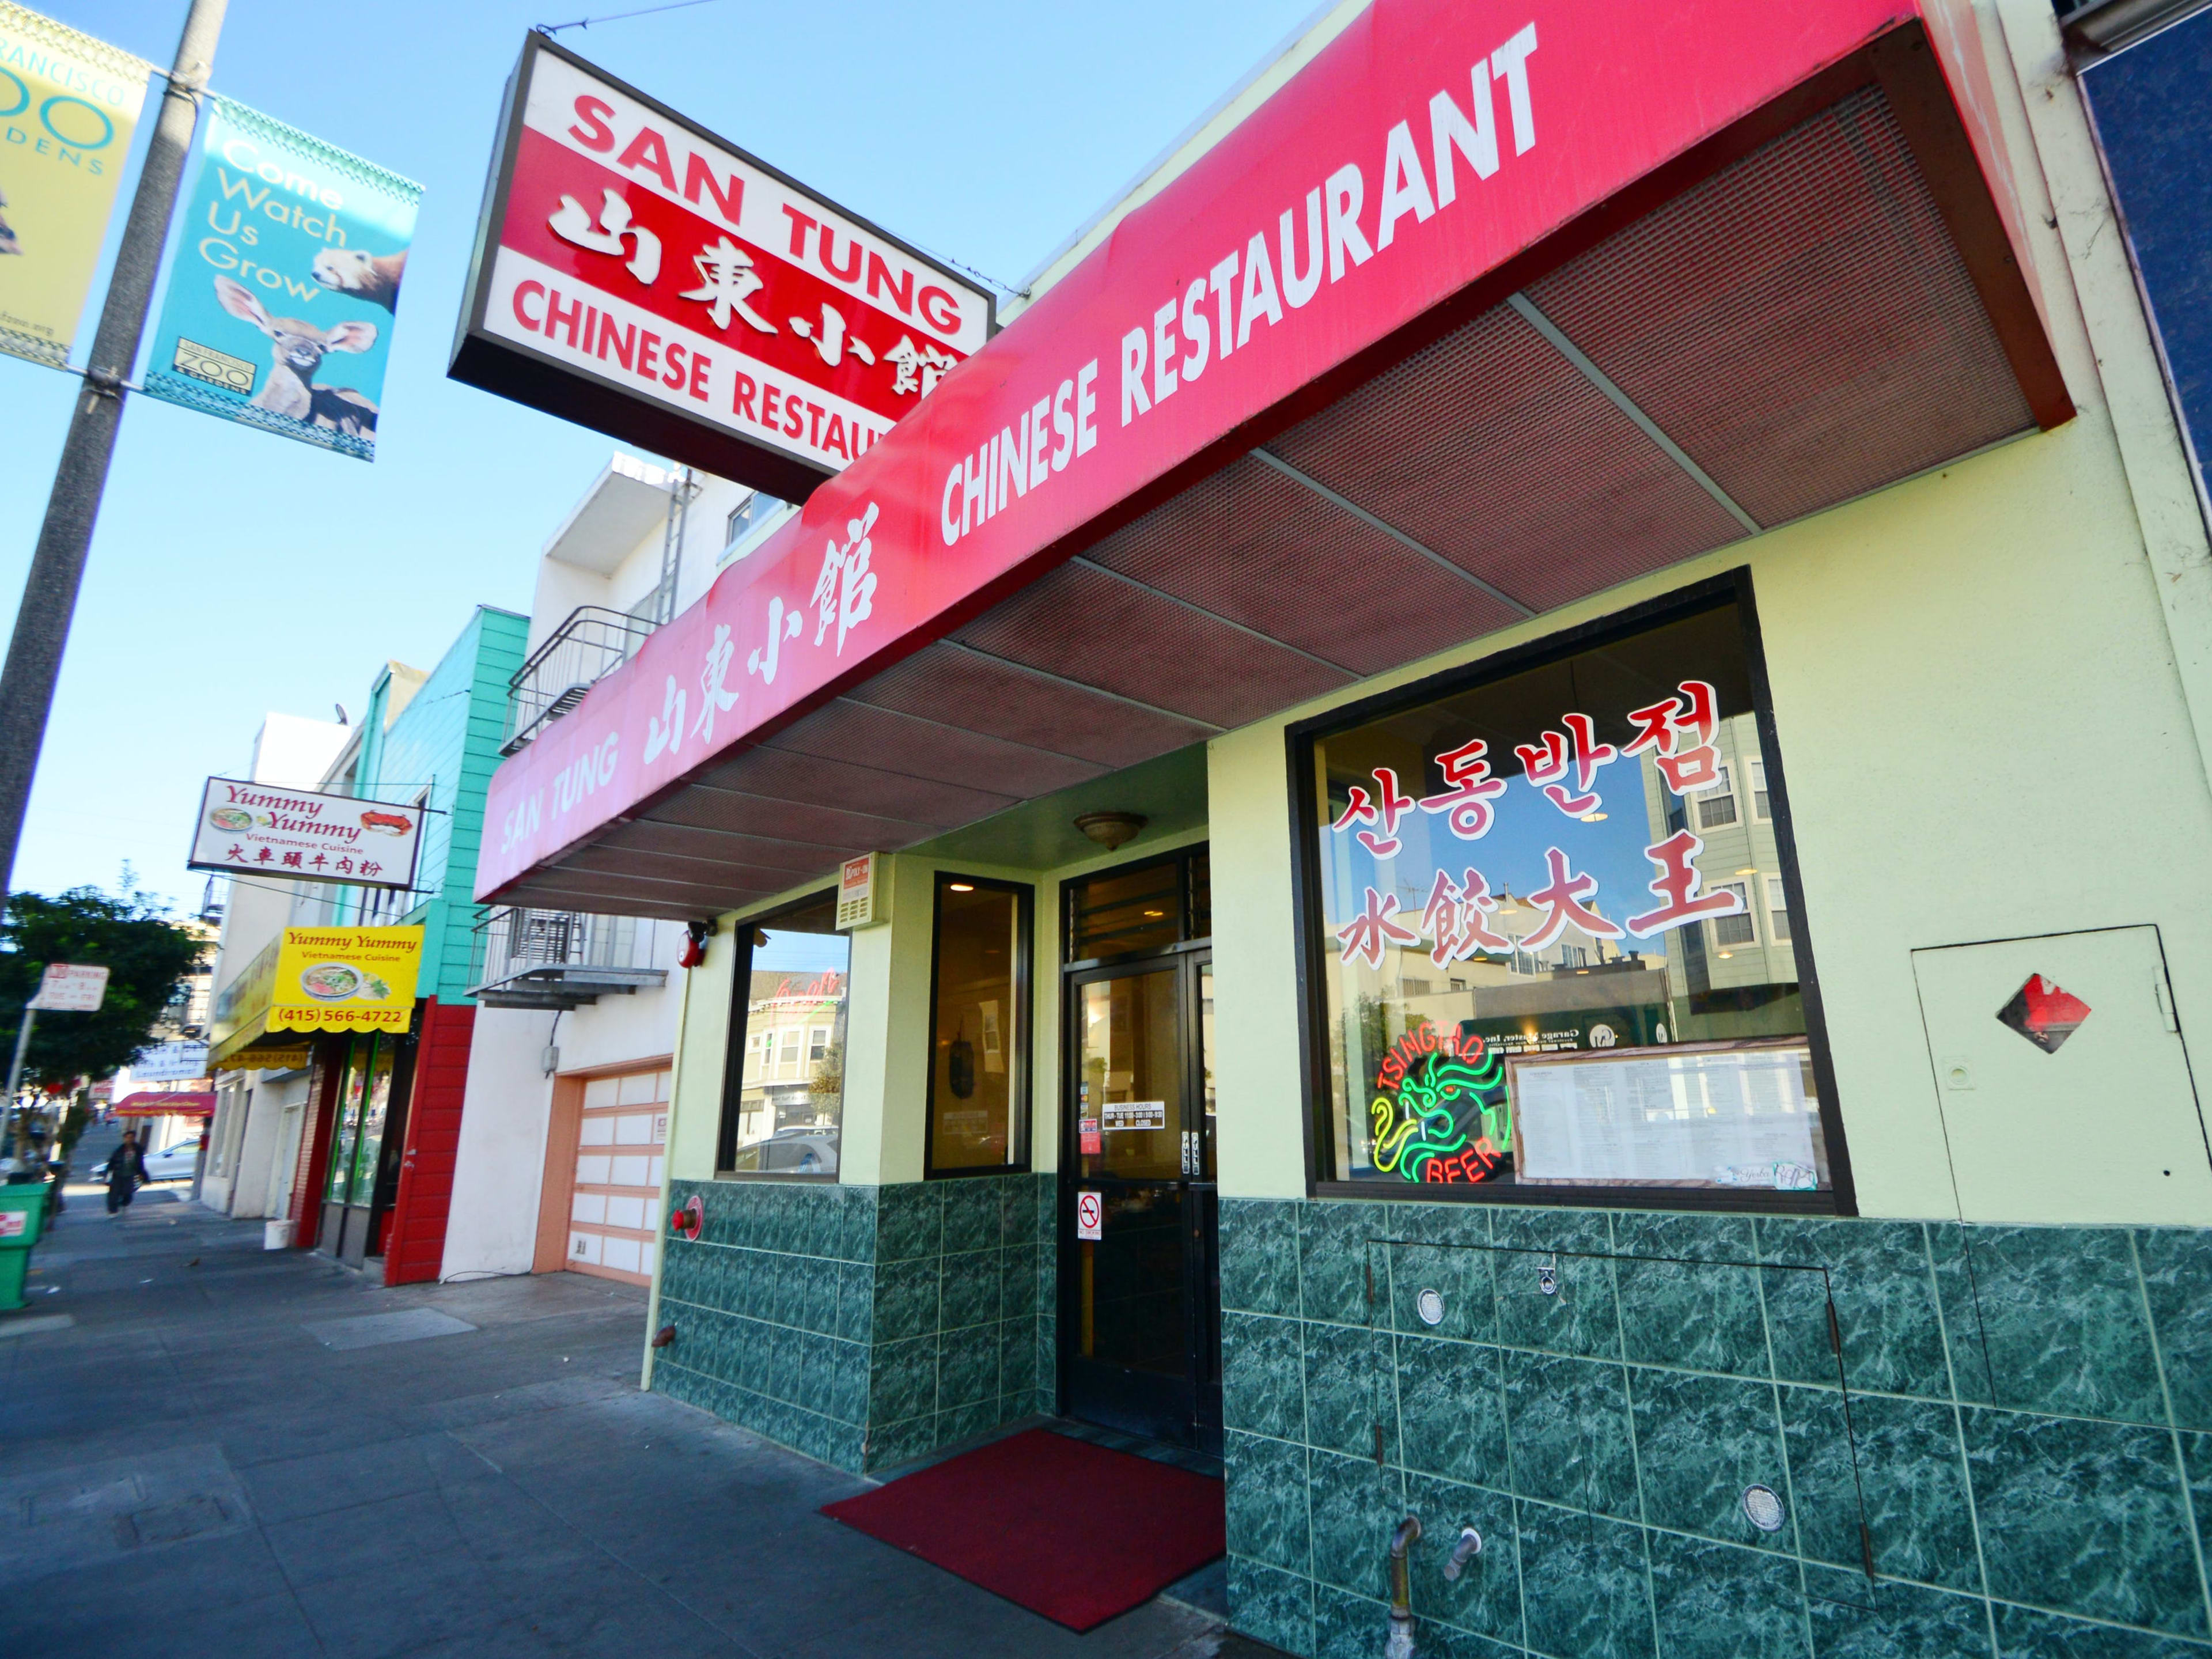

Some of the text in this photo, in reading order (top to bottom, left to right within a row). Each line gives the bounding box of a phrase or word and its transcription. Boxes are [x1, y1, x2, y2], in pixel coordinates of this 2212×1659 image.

[222, 139, 344, 211] Come
[208, 200, 259, 246] Us
[217, 166, 347, 247] Watch
[567, 94, 963, 337] SAN TUNG
[199, 237, 320, 302] Grow
[941, 21, 1539, 547] CHINESE RESTAURANT
[180, 351, 249, 386] ZOO
[512, 279, 885, 463] CHINESE RESTAU
[643, 501, 880, 765] 山東小館
[500, 731, 619, 855] SAN TUNG
[1332, 680, 1724, 860] 산동반점
[226, 785, 324, 819] Yummy
[246, 833, 364, 855] Vietnamese Cuisine
[267, 811, 362, 844] Yummy
[225, 843, 383, 877] 火車頭牛肉粉
[1336, 828, 1745, 970] 水餃大王
[288, 932, 418, 954] Yummy Yummy
[302, 951, 401, 963] Vietnamese Cuisine
[278, 1008, 402, 1023] (415) 566-4722
[1136, 1103, 1152, 1111] HOURS
[1426, 1136, 1502, 1184] BEER
